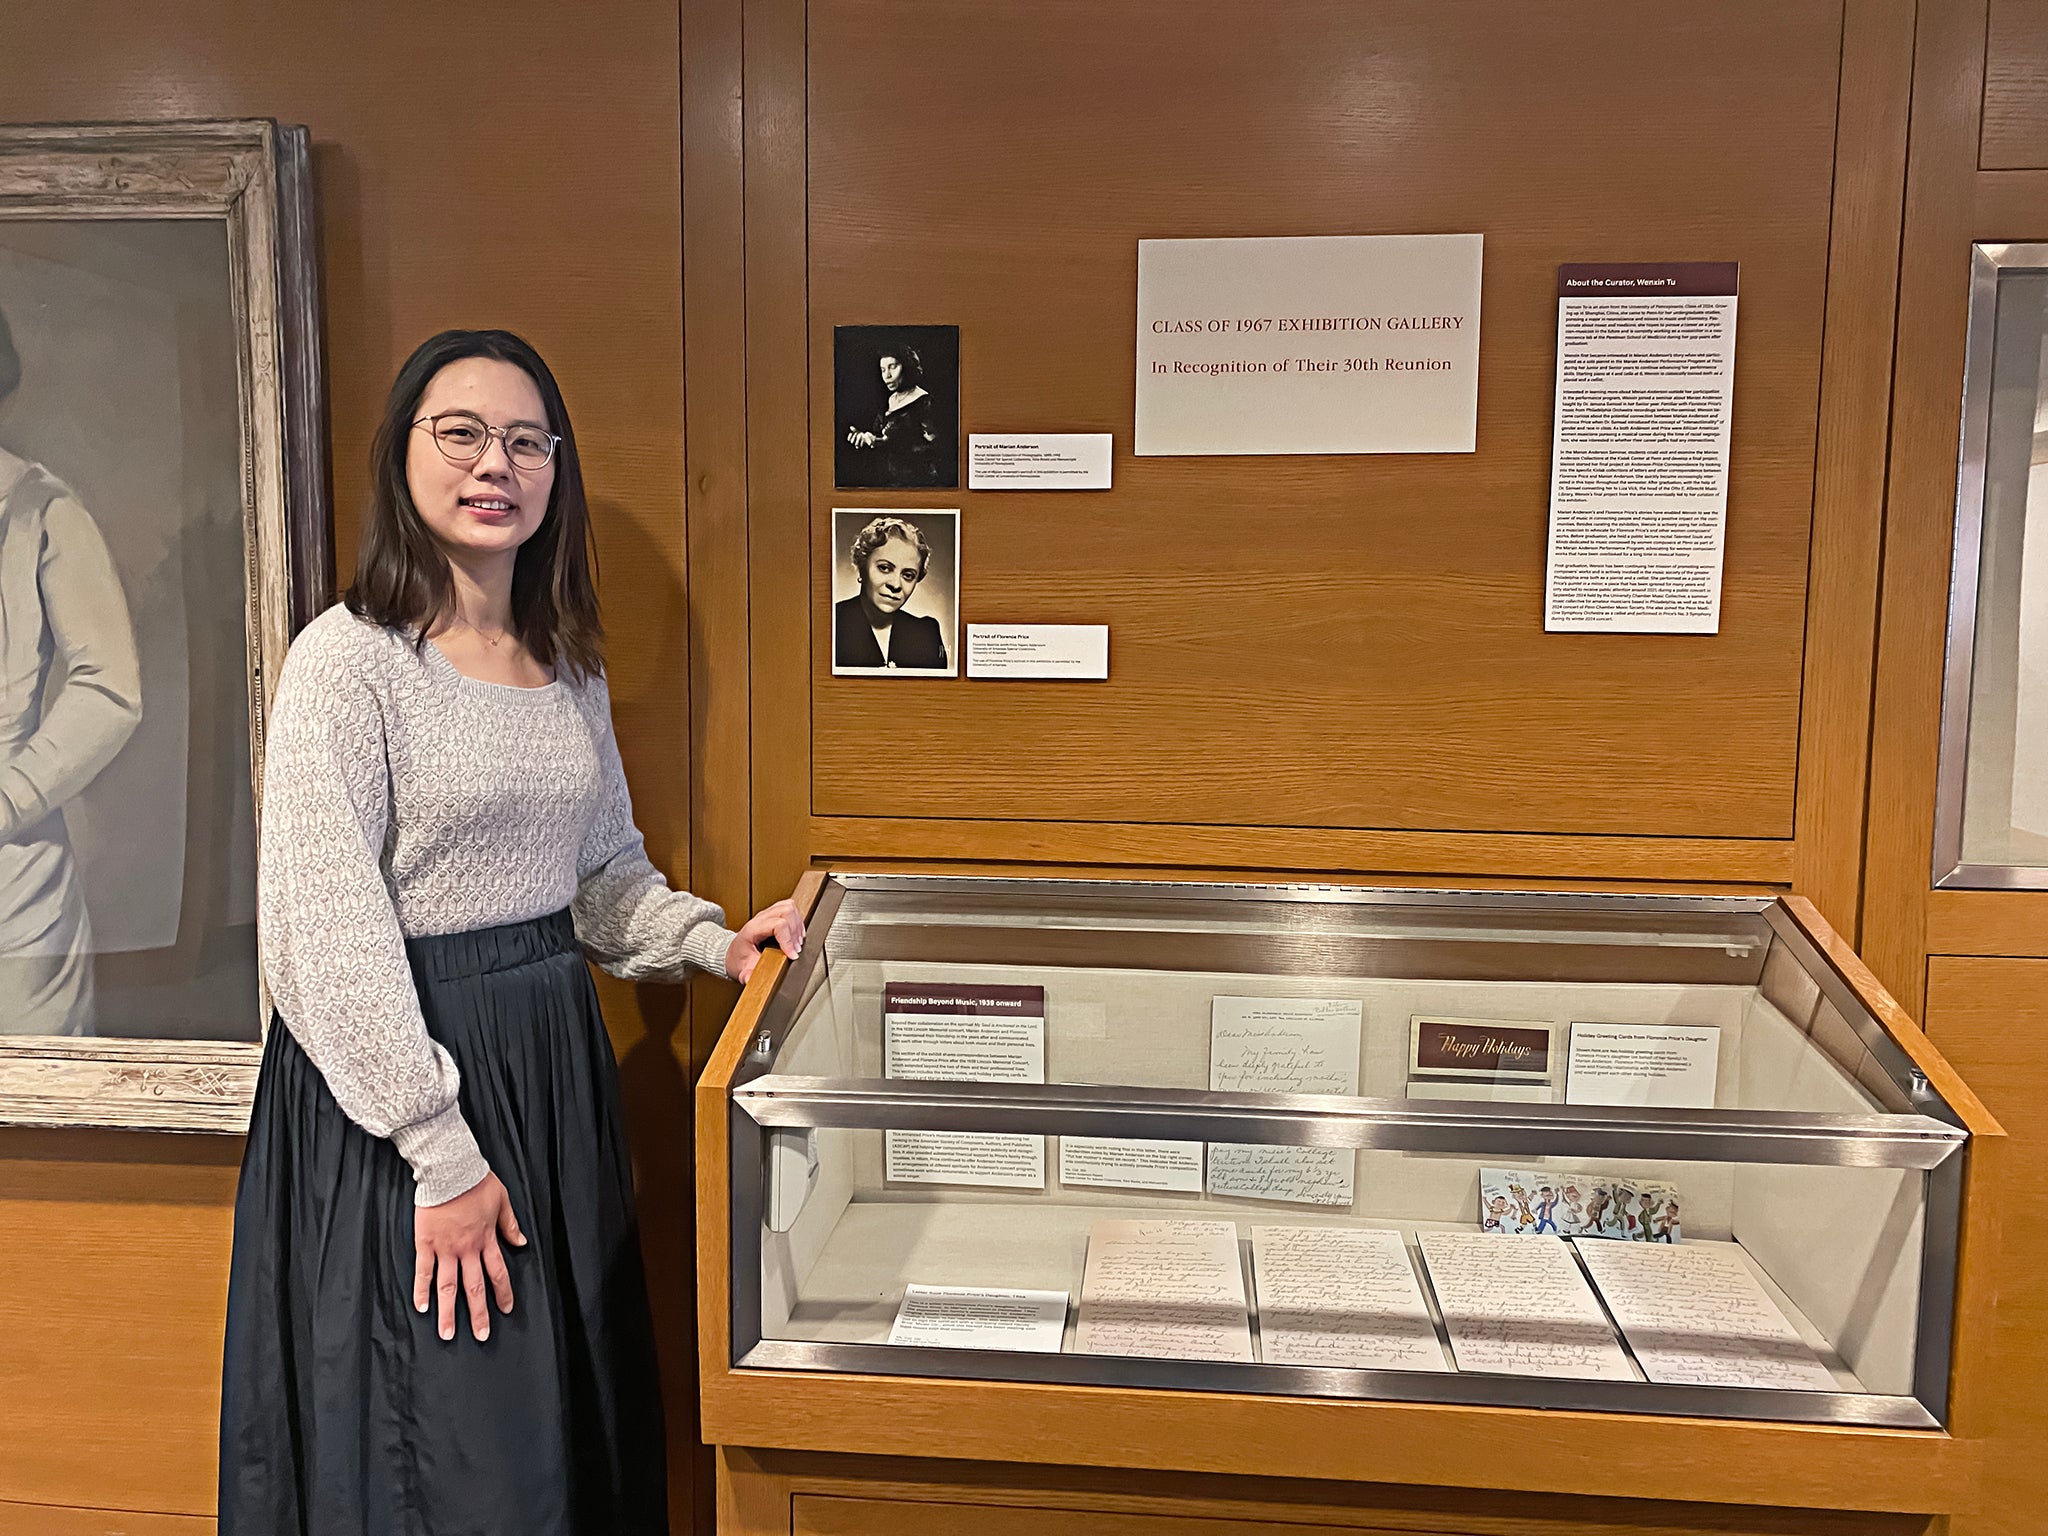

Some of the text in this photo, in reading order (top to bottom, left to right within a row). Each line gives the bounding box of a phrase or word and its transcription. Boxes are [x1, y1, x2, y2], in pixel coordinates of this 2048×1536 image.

[1604, 279, 1636, 287] Curator,
[1152, 317, 1464, 333] CLASS OF 1967 EXHIBITION GALLERY
[1152, 357, 1451, 376] In Recognition of Their 30th Reunion
[891, 997, 927, 1006] Friendship
[928, 998, 954, 1007] Beyond
[955, 998, 978, 1006] Music,
[1216, 1029, 1241, 1038] Dear
[1685, 1035, 1708, 1043] Daughter
[1241, 1045, 1259, 1063] My
[1438, 1033, 1531, 1060] Happy Holidays
[1242, 1059, 1269, 1074] deeply
[1272, 1062, 1310, 1076] grateful
[1237, 1071, 1253, 1088] for
[1257, 1073, 1302, 1086] including
[1210, 1147, 1230, 1161] pay
[1234, 1149, 1253, 1161] my
